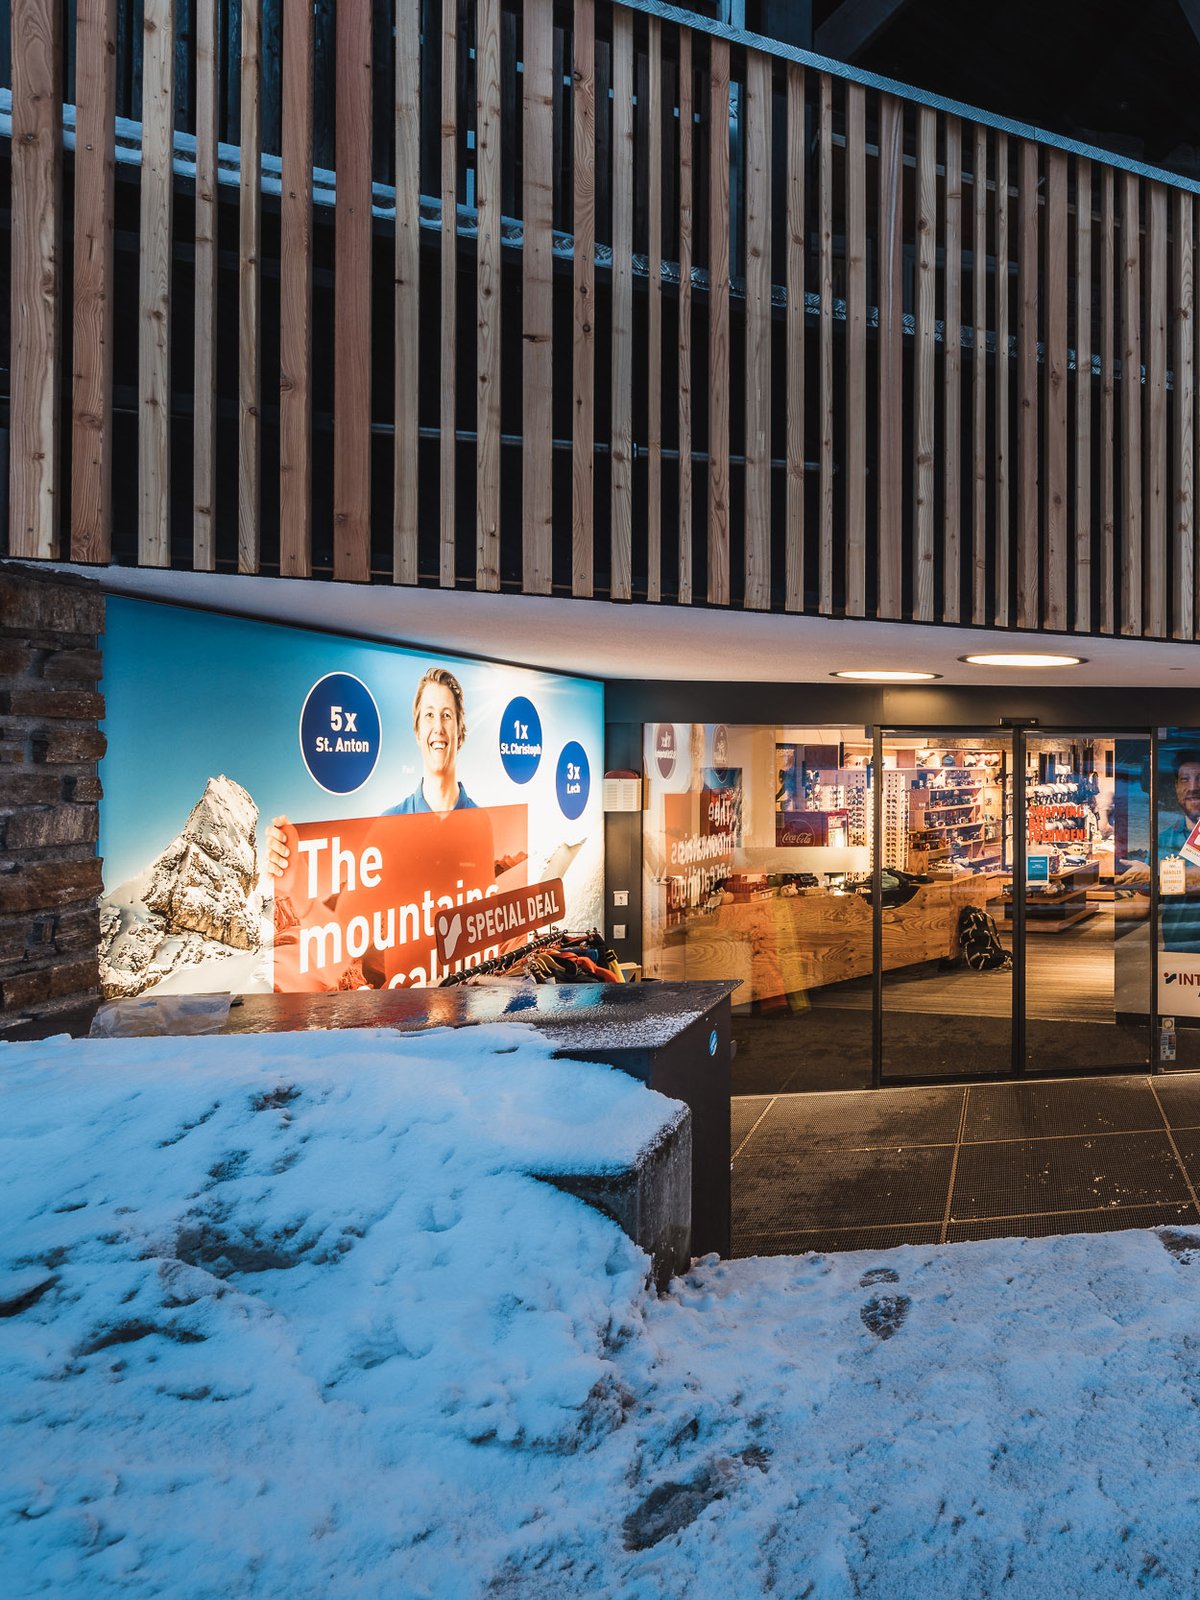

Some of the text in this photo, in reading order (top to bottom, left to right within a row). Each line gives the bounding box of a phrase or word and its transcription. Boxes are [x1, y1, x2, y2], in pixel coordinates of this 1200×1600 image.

[330, 705, 357, 732] 5x
[513, 719, 529, 740] 1x
[315, 736, 369, 753] St. Anton
[510, 743, 541, 757] Christoph
[567, 762, 581, 780] 3x
[566, 783, 581, 794] Lech
[1028, 804, 1085, 818] SHOPPING
[1028, 829, 1088, 842] FREUNDEN!
[298, 836, 383, 899] The
[466, 890, 560, 944] SPECIAL DEAL
